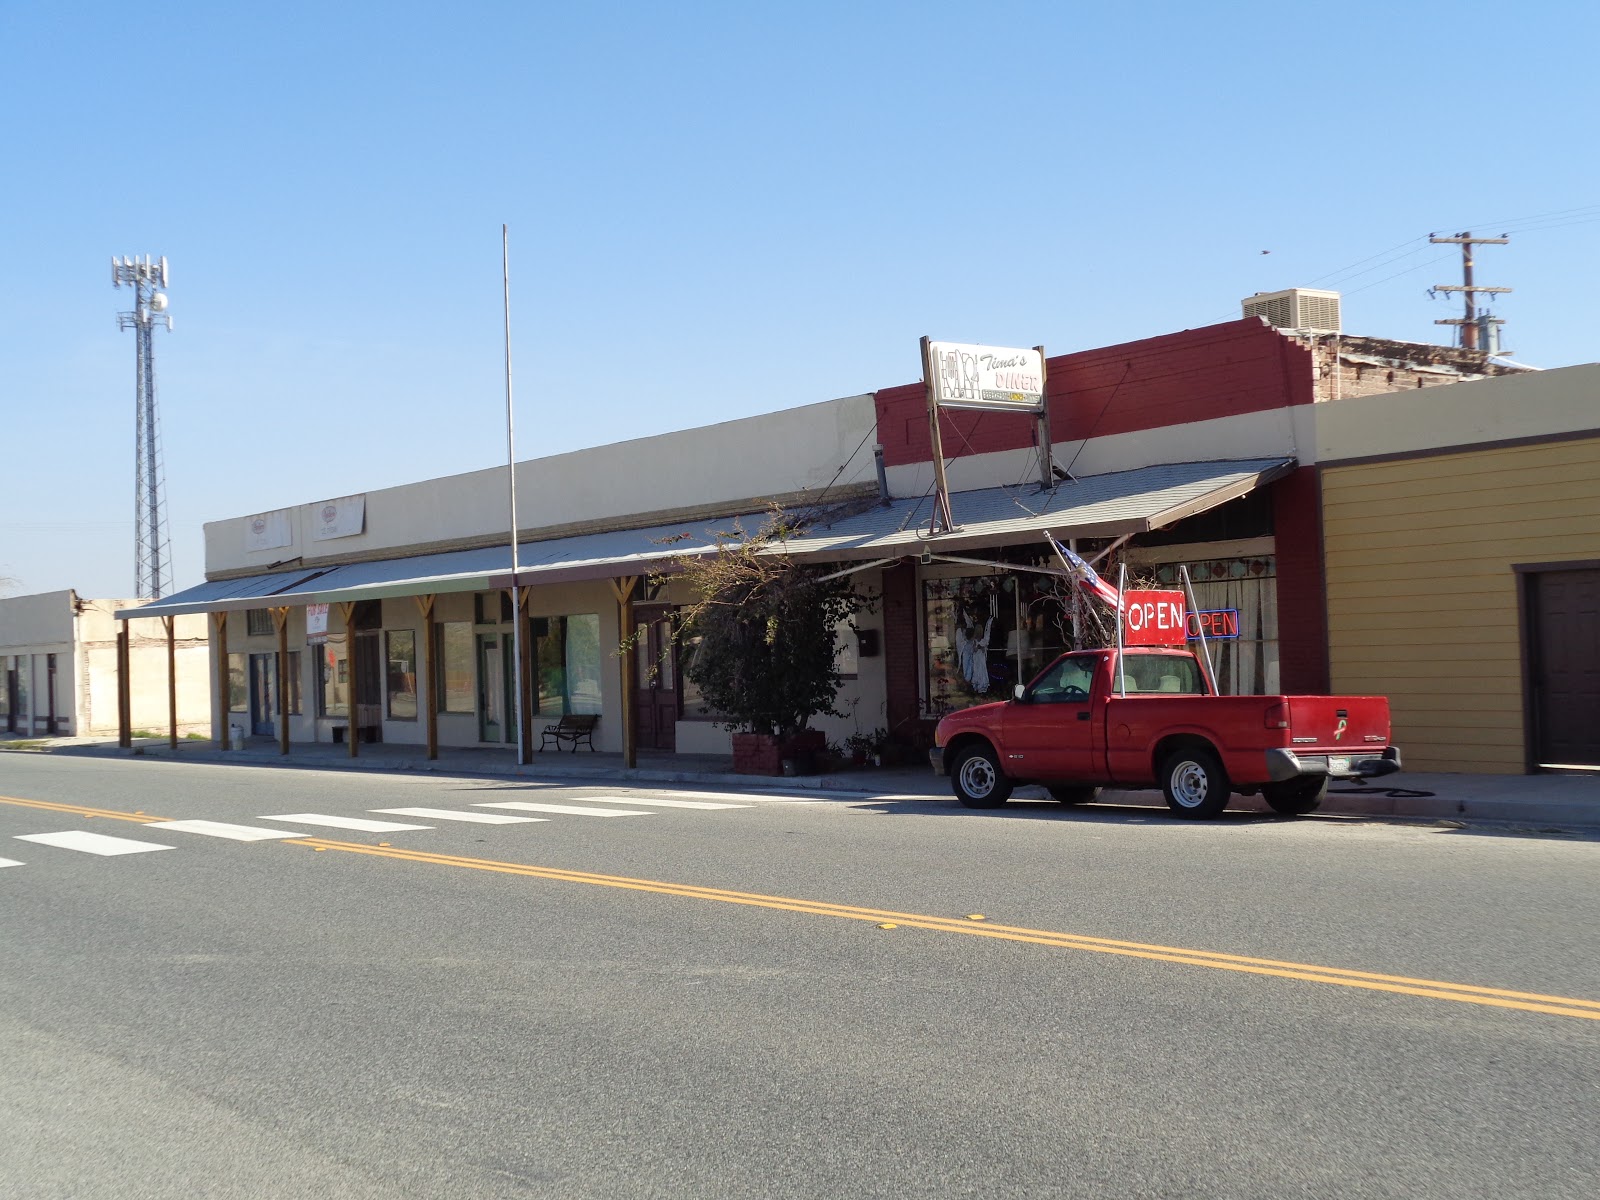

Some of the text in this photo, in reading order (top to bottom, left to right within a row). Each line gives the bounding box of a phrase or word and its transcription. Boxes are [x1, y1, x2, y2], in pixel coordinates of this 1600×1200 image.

[980, 353, 1027, 371] Tina's
[995, 372, 1038, 392] DINER
[1128, 603, 1183, 630] OPEN
[1186, 612, 1238, 636] OPEN
